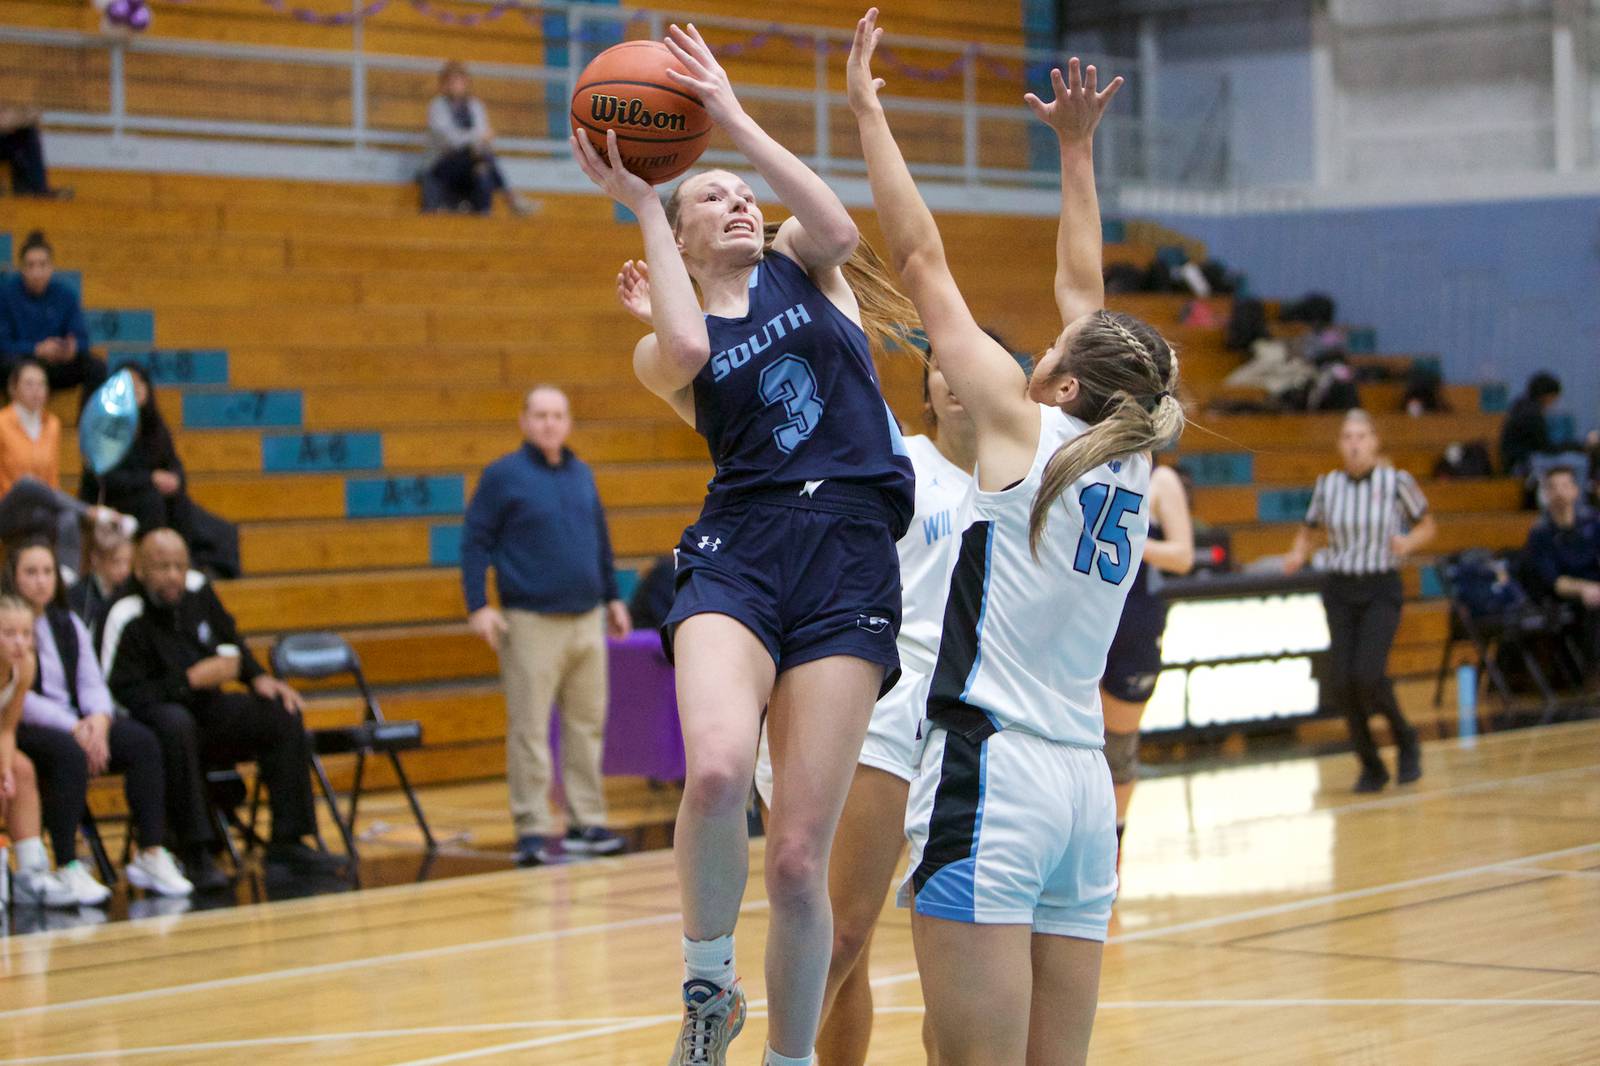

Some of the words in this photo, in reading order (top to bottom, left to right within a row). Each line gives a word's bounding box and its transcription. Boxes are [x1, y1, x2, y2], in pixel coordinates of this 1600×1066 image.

[591, 94, 687, 130] Wilson
[711, 303, 812, 383] SOUTH
[758, 353, 824, 455] 3
[922, 507, 959, 546] WIL
[1073, 481, 1144, 586] 15
